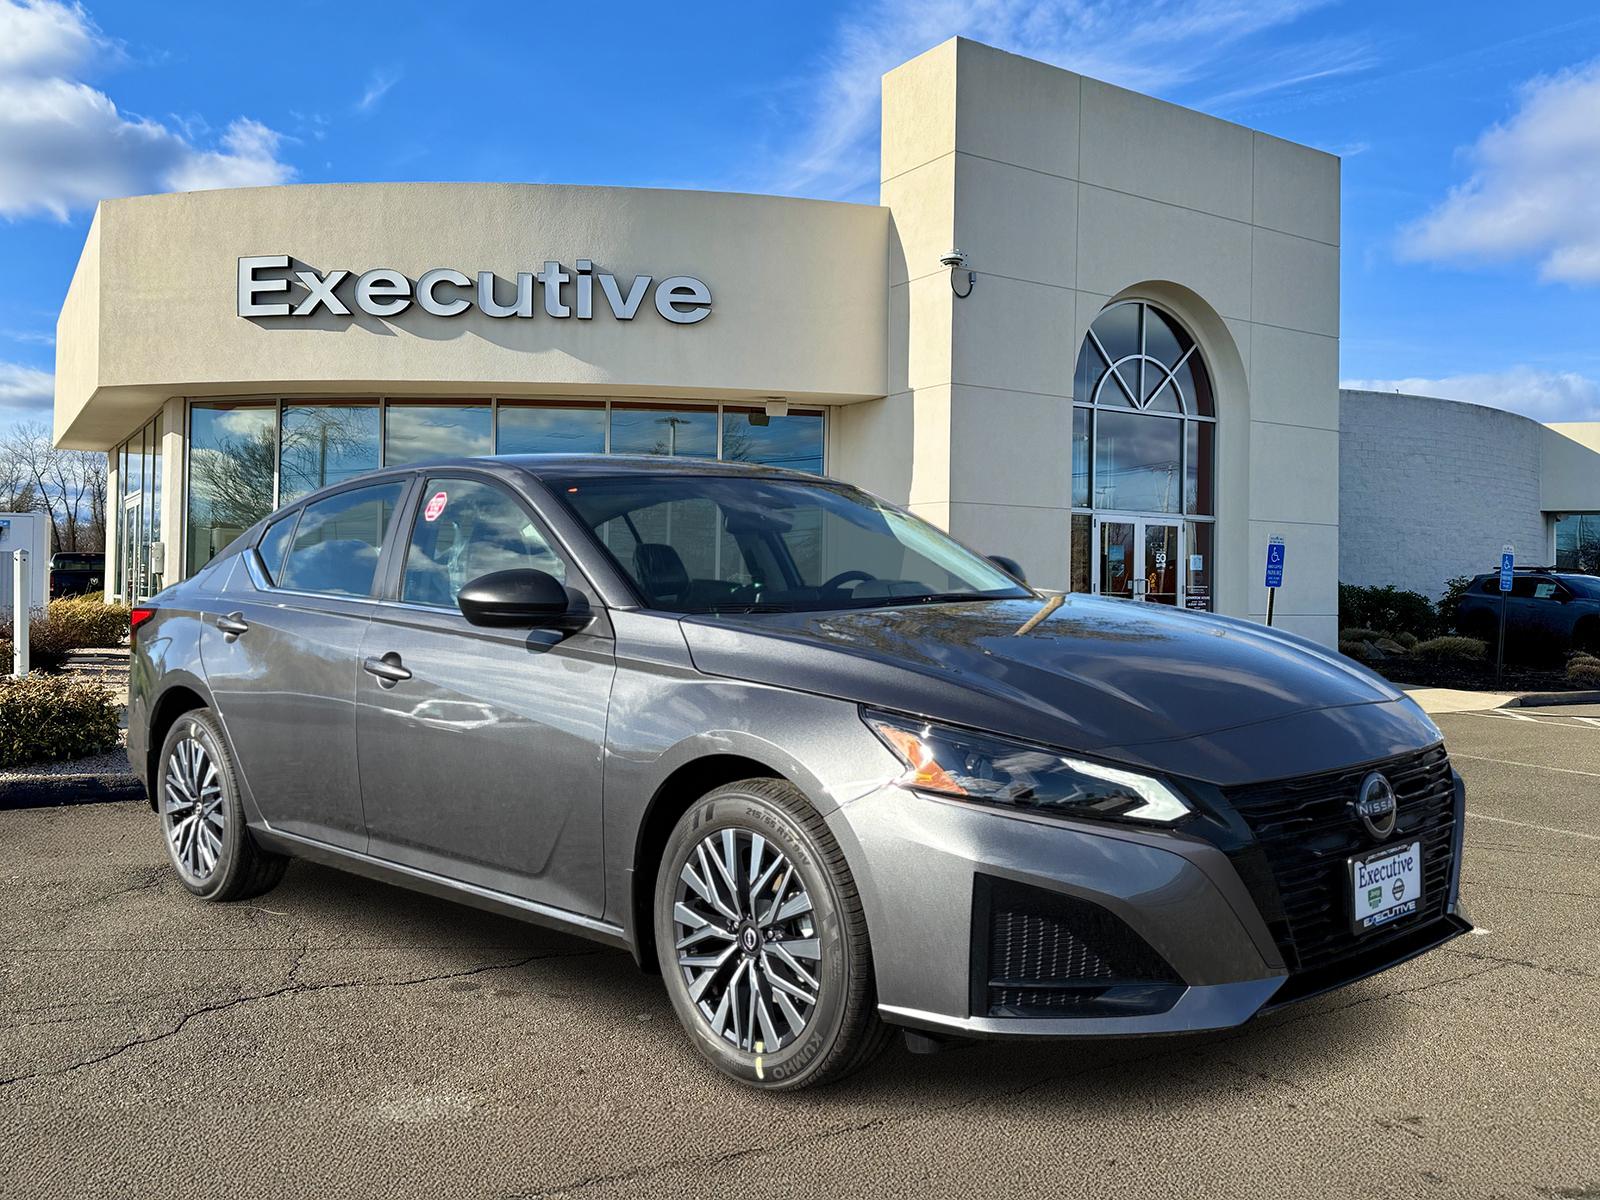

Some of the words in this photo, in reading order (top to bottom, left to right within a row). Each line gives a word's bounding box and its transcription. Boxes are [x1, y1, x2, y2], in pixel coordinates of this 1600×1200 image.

[237, 255, 713, 324] Executive
[1155, 553, 1166, 563] 50
[745, 807, 777, 829] 215/55
[777, 826, 795, 842] R17
[1359, 799, 1393, 815] NISSA
[1358, 854, 1414, 889] Executive
[773, 1031, 824, 1079] KUMHO
